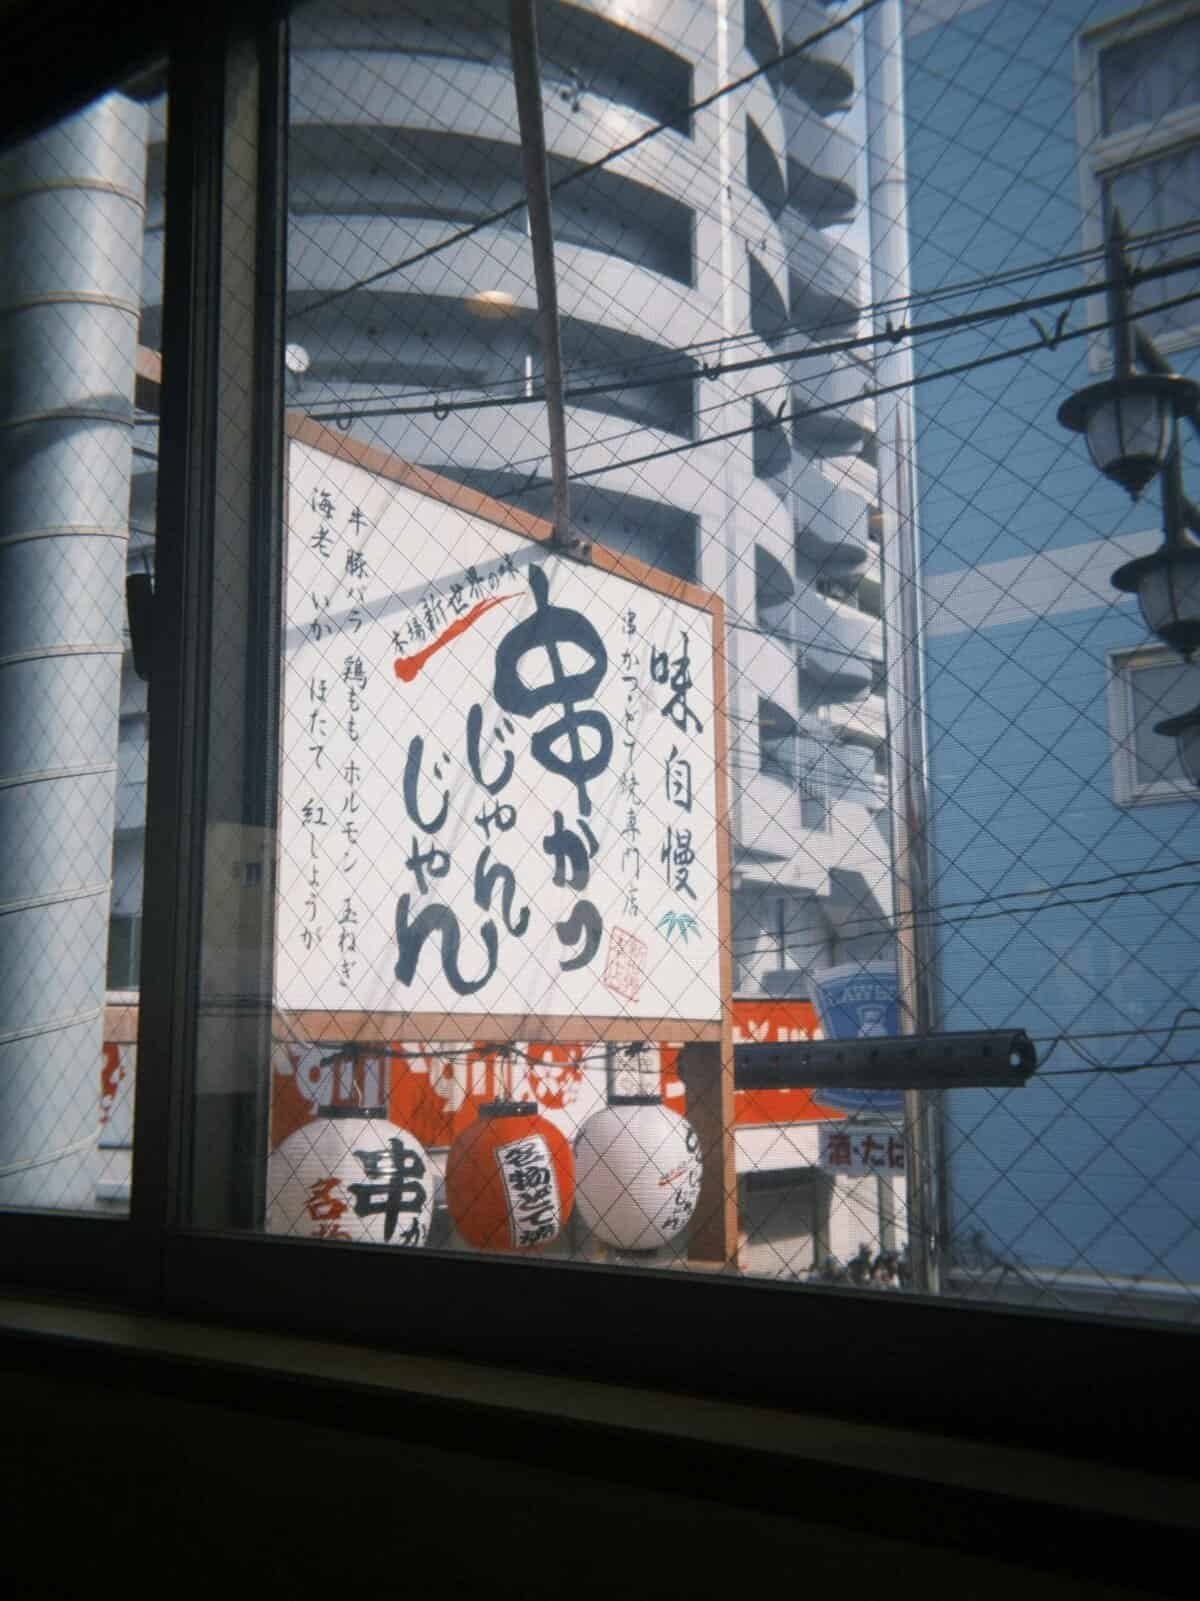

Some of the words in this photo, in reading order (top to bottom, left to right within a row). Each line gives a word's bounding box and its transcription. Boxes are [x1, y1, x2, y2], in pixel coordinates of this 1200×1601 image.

[311, 487, 336, 558] 海老
[348, 506, 368, 536] 牛
[310, 592, 333, 641] いか
[345, 549, 369, 633] 豚バラ
[391, 553, 520, 654] 本場新世界の味
[309, 676, 327, 769] ほたて
[343, 656, 367, 741] 鶏もも
[493, 562, 614, 972] 串かつ
[650, 631, 704, 901] 味自慢
[341, 760, 360, 873] ホルモン
[300, 798, 329, 950] 紅しょうが
[335, 898, 359, 987] 玉ねぎ
